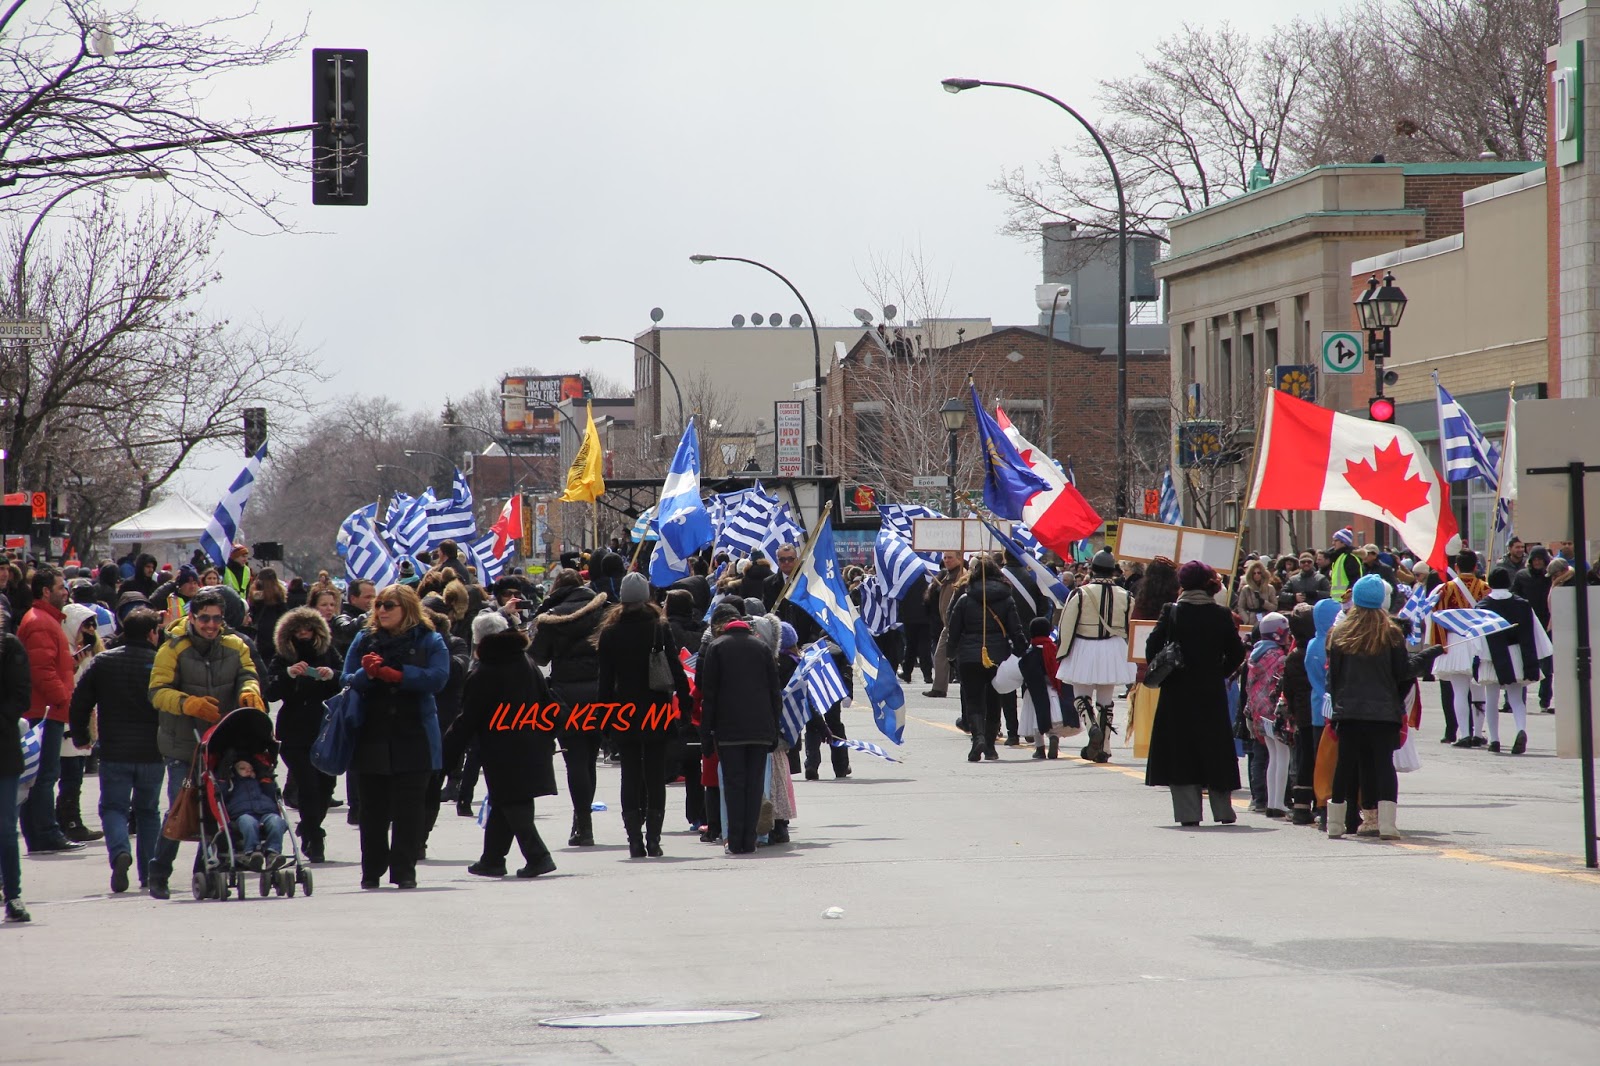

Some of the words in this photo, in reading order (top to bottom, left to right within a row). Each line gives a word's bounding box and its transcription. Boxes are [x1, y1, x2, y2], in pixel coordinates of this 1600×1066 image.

[0, 326, 41, 334] QUERBES
[526, 381, 539, 391] JACK
[779, 428, 800, 436] INDO
[780, 438, 800, 446] PAK
